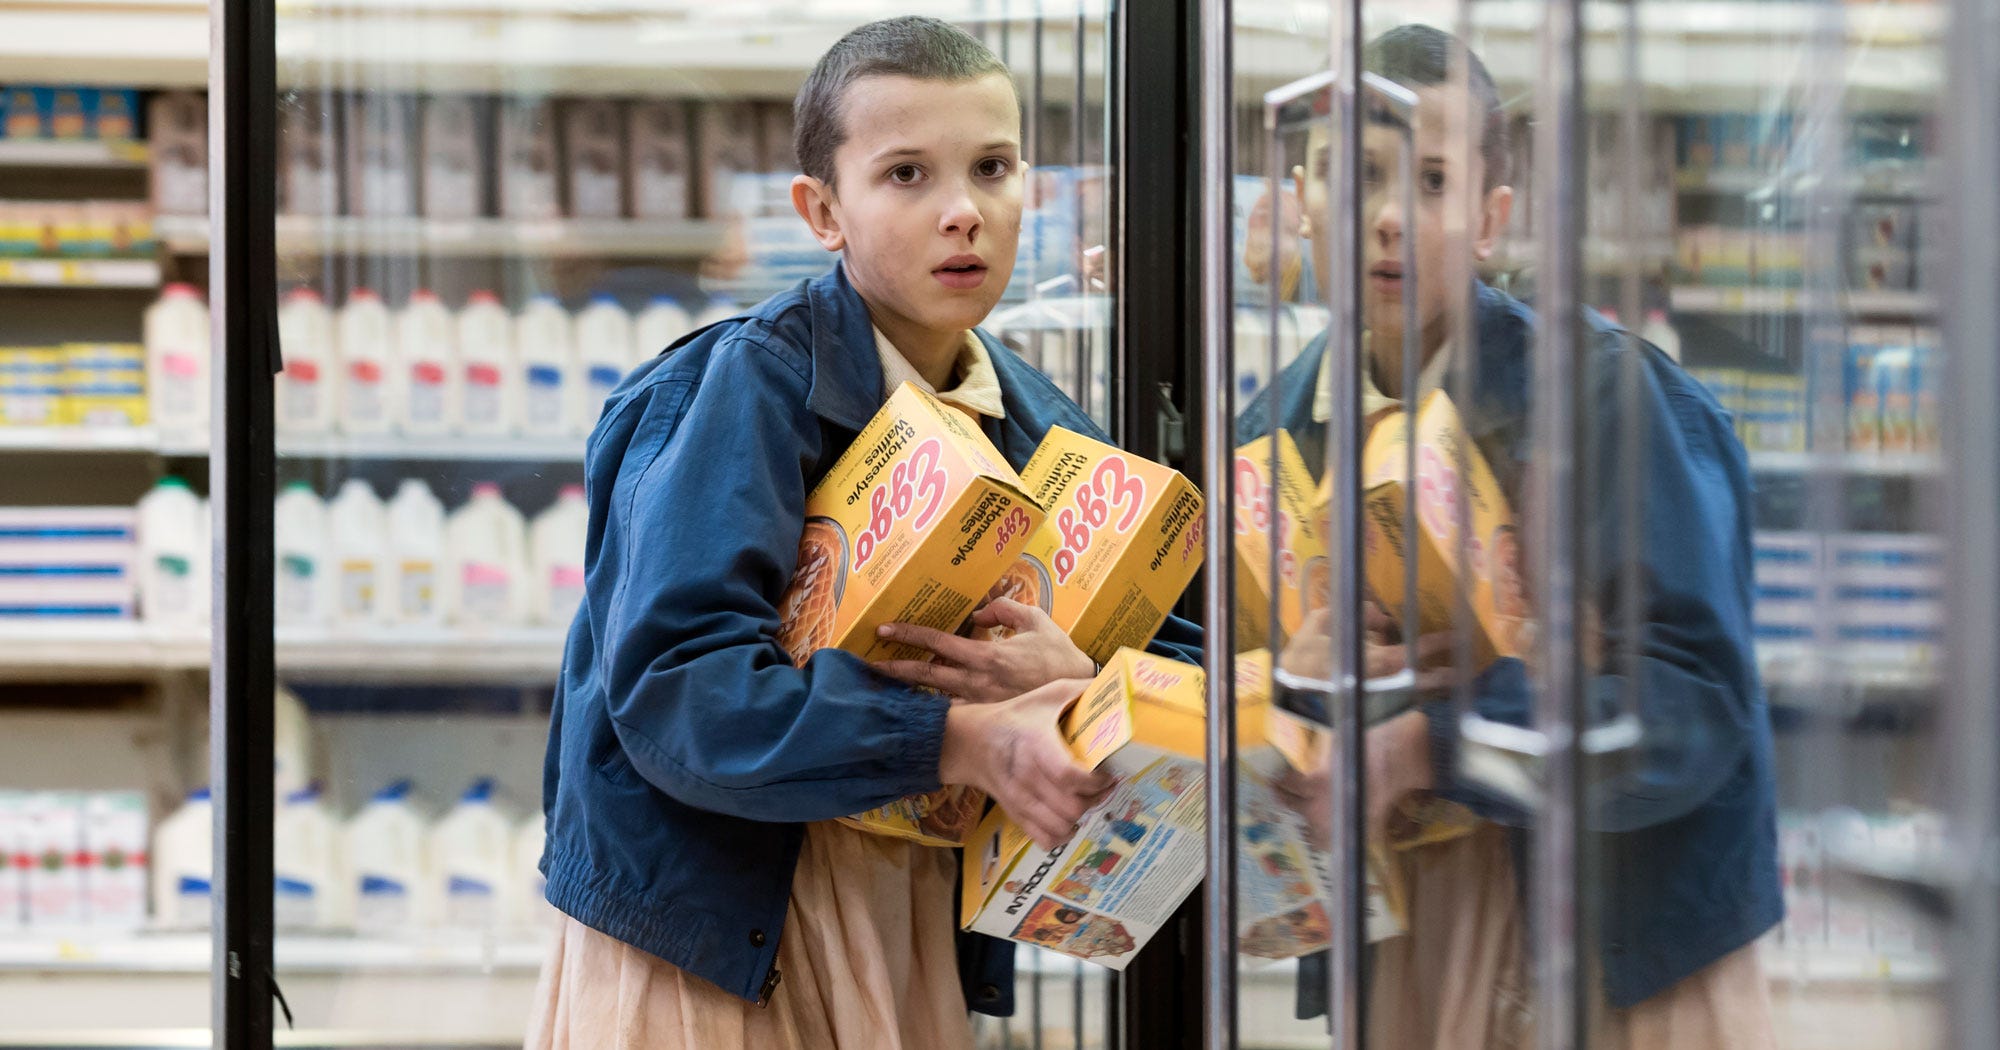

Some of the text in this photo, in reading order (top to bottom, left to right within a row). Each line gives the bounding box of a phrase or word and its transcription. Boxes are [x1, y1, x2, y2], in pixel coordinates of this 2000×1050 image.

[864, 419, 909, 466] Waffles
[905, 427, 915, 438] 8
[847, 435, 907, 505] Homestyle
[1036, 452, 1076, 499] Waffles
[1075, 455, 1087, 463] 8
[853, 438, 947, 572] Eggo
[1000, 496, 1011, 506] 8
[1043, 464, 1082, 511] Homes
[951, 505, 1005, 566] Homestyle
[961, 492, 1000, 534] Waffles
[995, 506, 1031, 556] Eggo
[1054, 455, 1144, 584] Eggo
[1151, 499, 1199, 571] 8 Homestyle
[1161, 491, 1192, 534] Waffles
[1005, 843, 1068, 915] INTRODUC
